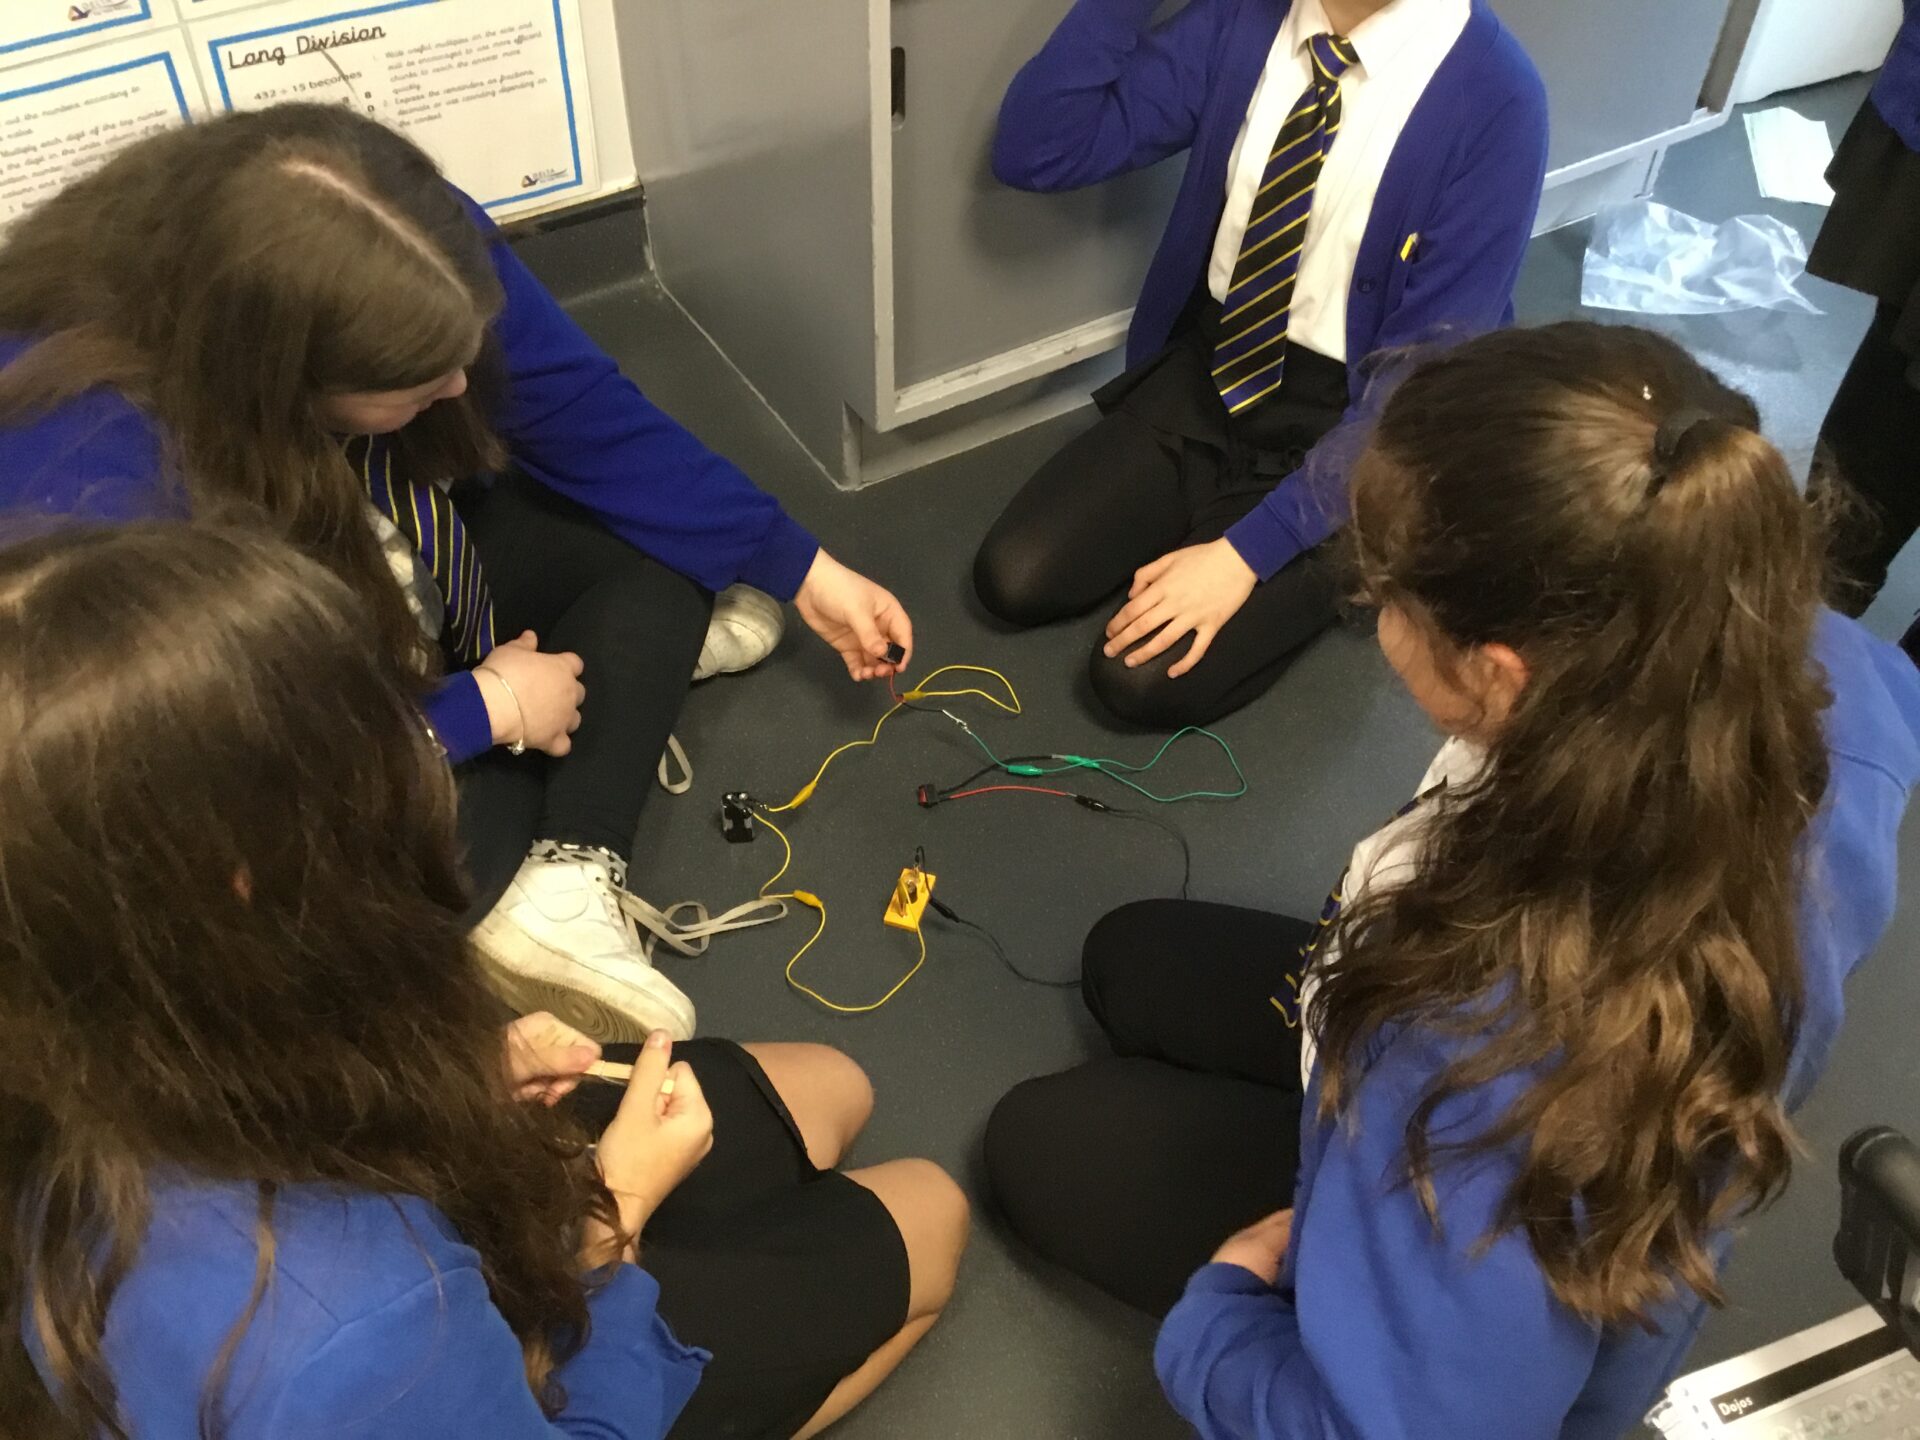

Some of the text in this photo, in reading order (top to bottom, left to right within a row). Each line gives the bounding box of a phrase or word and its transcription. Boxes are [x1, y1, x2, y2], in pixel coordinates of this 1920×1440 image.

[228, 25, 386, 70] Long Division
[254, 89, 276, 101] 432
[293, 83, 306, 92] 15
[309, 70, 362, 88] becomes
[1717, 1396, 1753, 1416] Dojos
